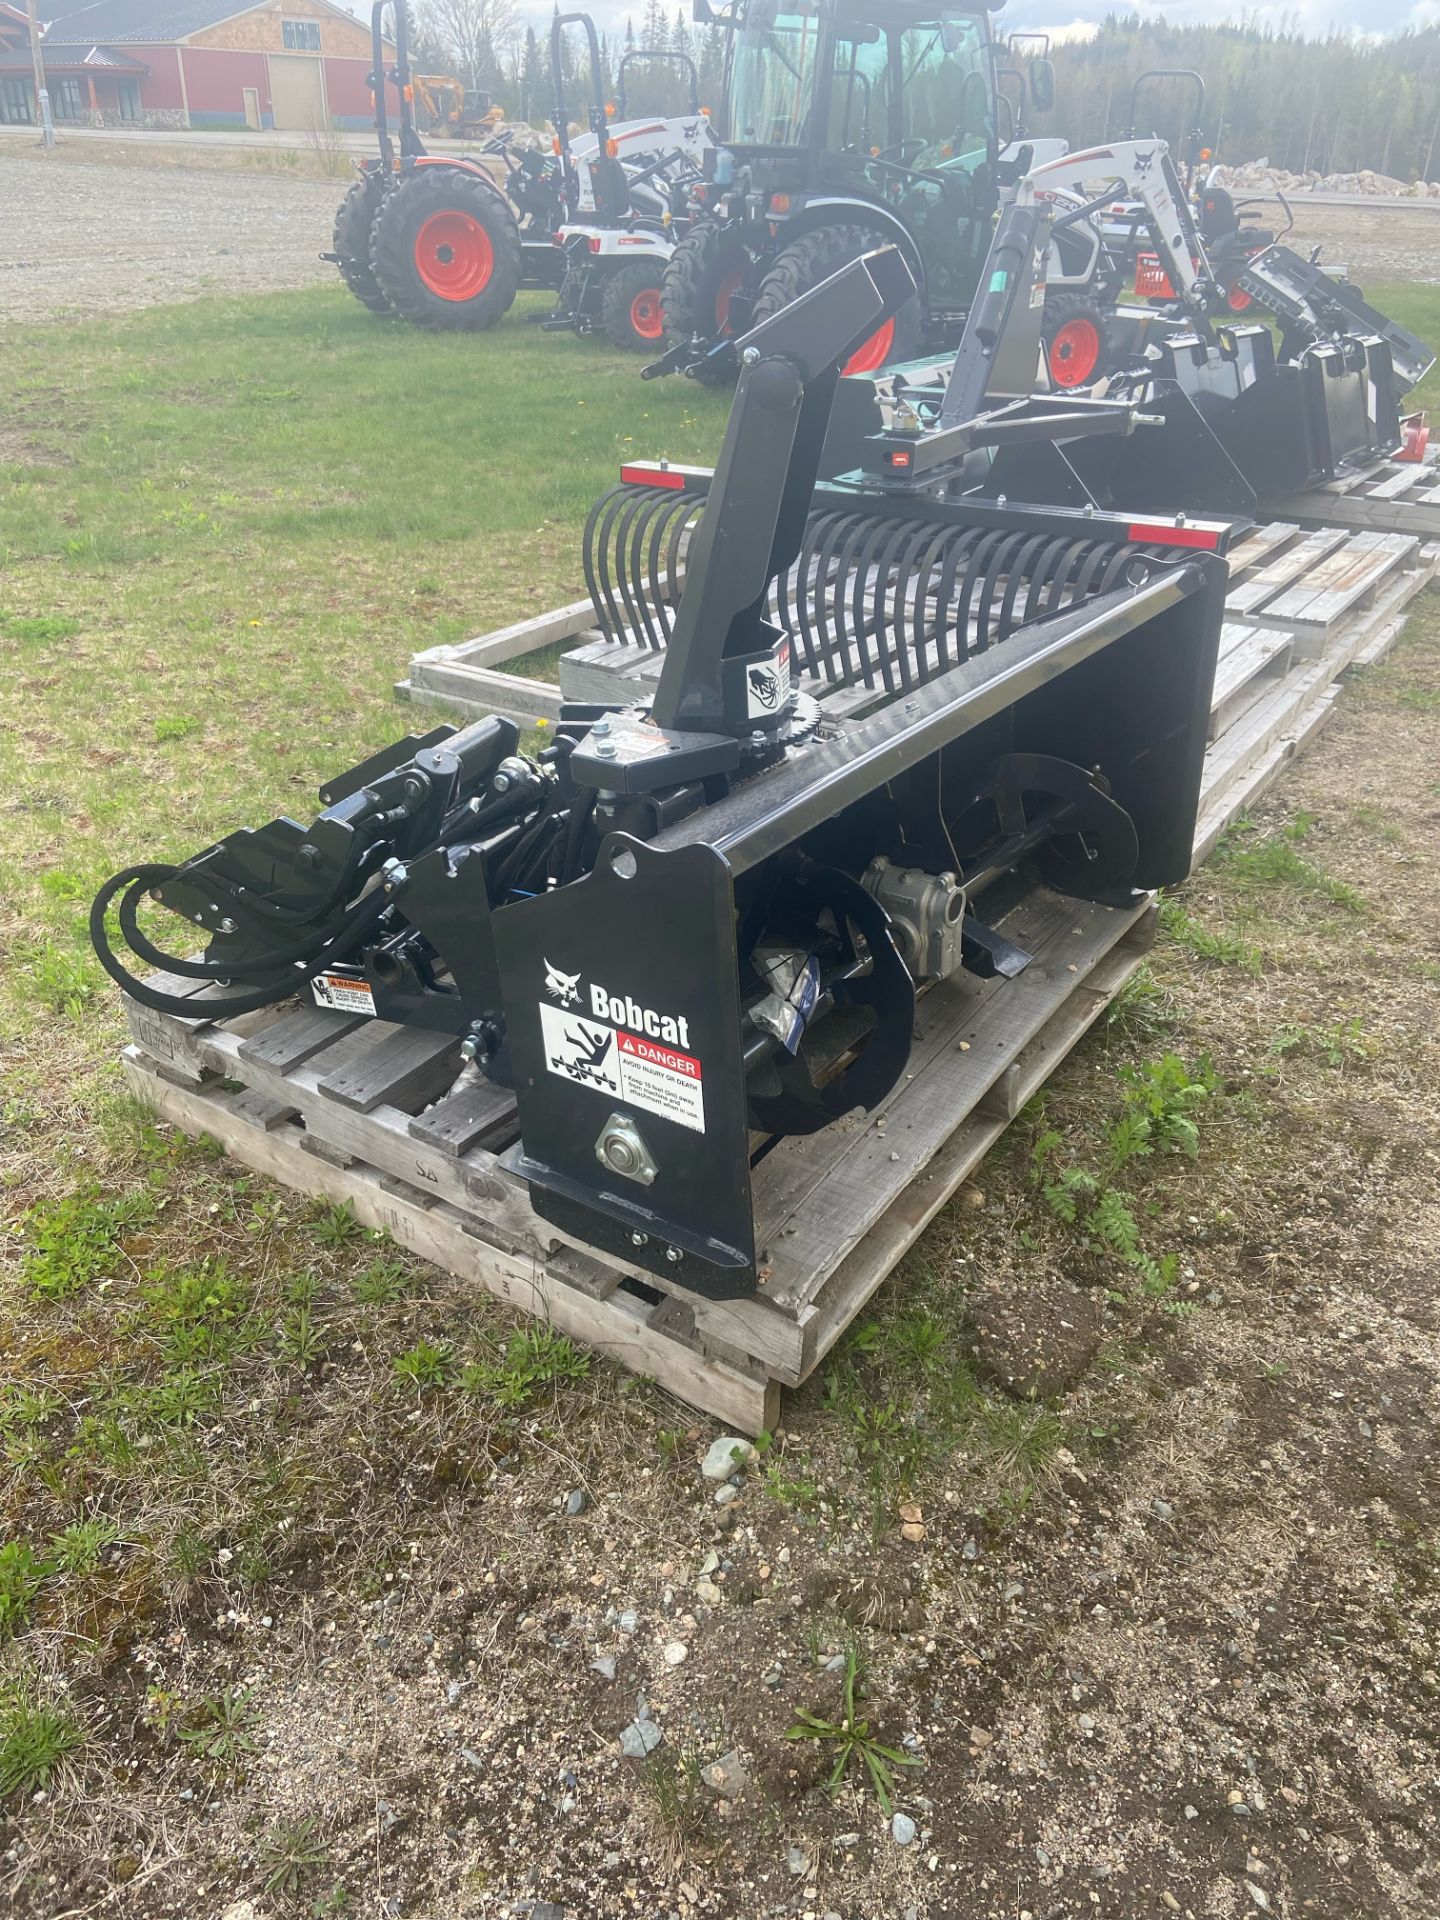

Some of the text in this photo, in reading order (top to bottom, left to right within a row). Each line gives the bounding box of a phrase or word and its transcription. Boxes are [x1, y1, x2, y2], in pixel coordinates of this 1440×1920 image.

[338, 980, 369, 990] WARNING
[590, 983, 690, 1050] Bobcat
[622, 1058, 698, 1092] AVOID INJURY OR DEATH
[637, 1044, 695, 1075] DANGER
[628, 1075, 643, 1086] Keep
[651, 1084, 664, 1093] feet
[678, 1095, 694, 1106] away
[628, 1081, 681, 1106] from machine and
[629, 1089, 662, 1105] attachment
[663, 1101, 679, 1112] when
[686, 1111, 700, 1120] use.
